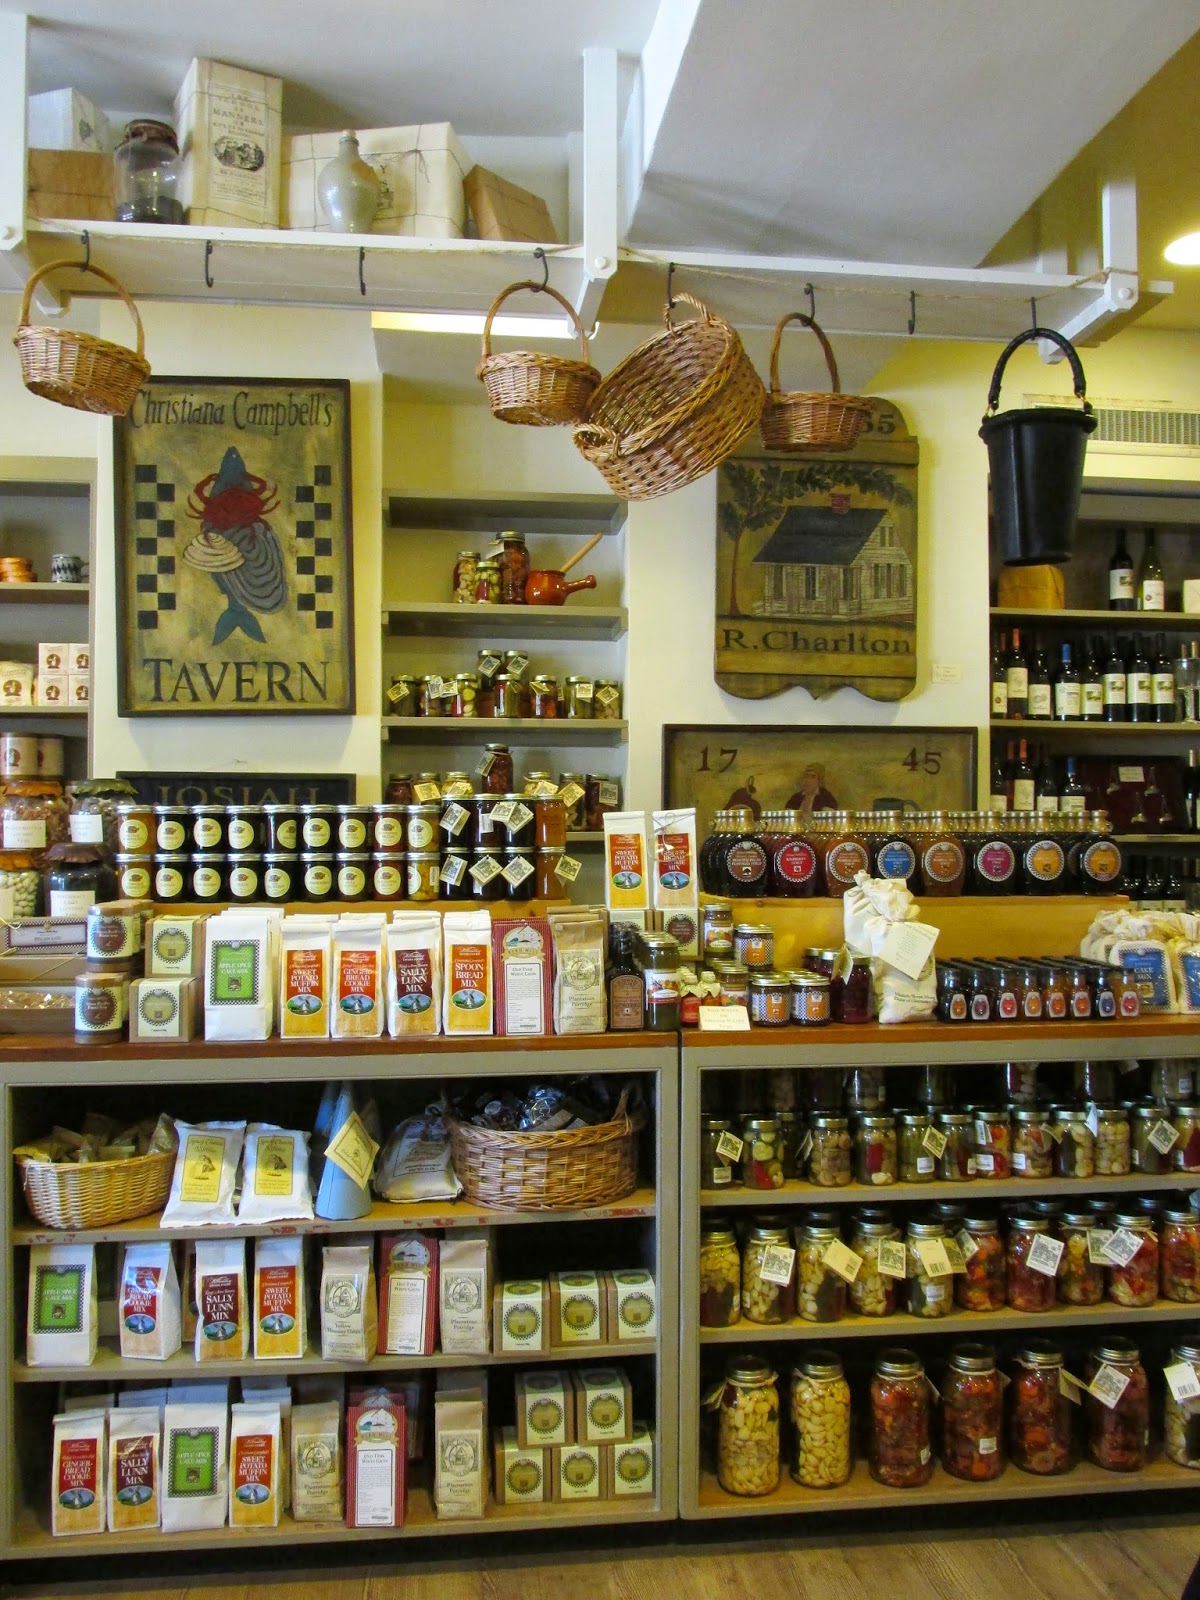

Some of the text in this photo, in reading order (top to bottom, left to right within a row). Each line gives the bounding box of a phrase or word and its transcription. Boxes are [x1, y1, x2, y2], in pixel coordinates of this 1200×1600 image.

[131, 389, 332, 436] Christiana Campbell's
[143, 658, 330, 703] TAVERN
[697, 746, 942, 775] 17 45
[455, 963, 484, 971] SPOON
[400, 968, 428, 976] SALLY
[456, 971, 484, 979] BREAD
[401, 976, 427, 984] LUNN
[461, 980, 478, 988] MIX
[406, 984, 423, 992] MIX
[206, 1294, 233, 1303] SALLY
[207, 1303, 233, 1312] LUNN
[212, 1312, 229, 1320] MIX
[121, 1458, 147, 1467] SALLY
[121, 1467, 148, 1476] LUNN
[239, 1468, 267, 1476] MUFFIN
[126, 1477, 144, 1485] MIX
